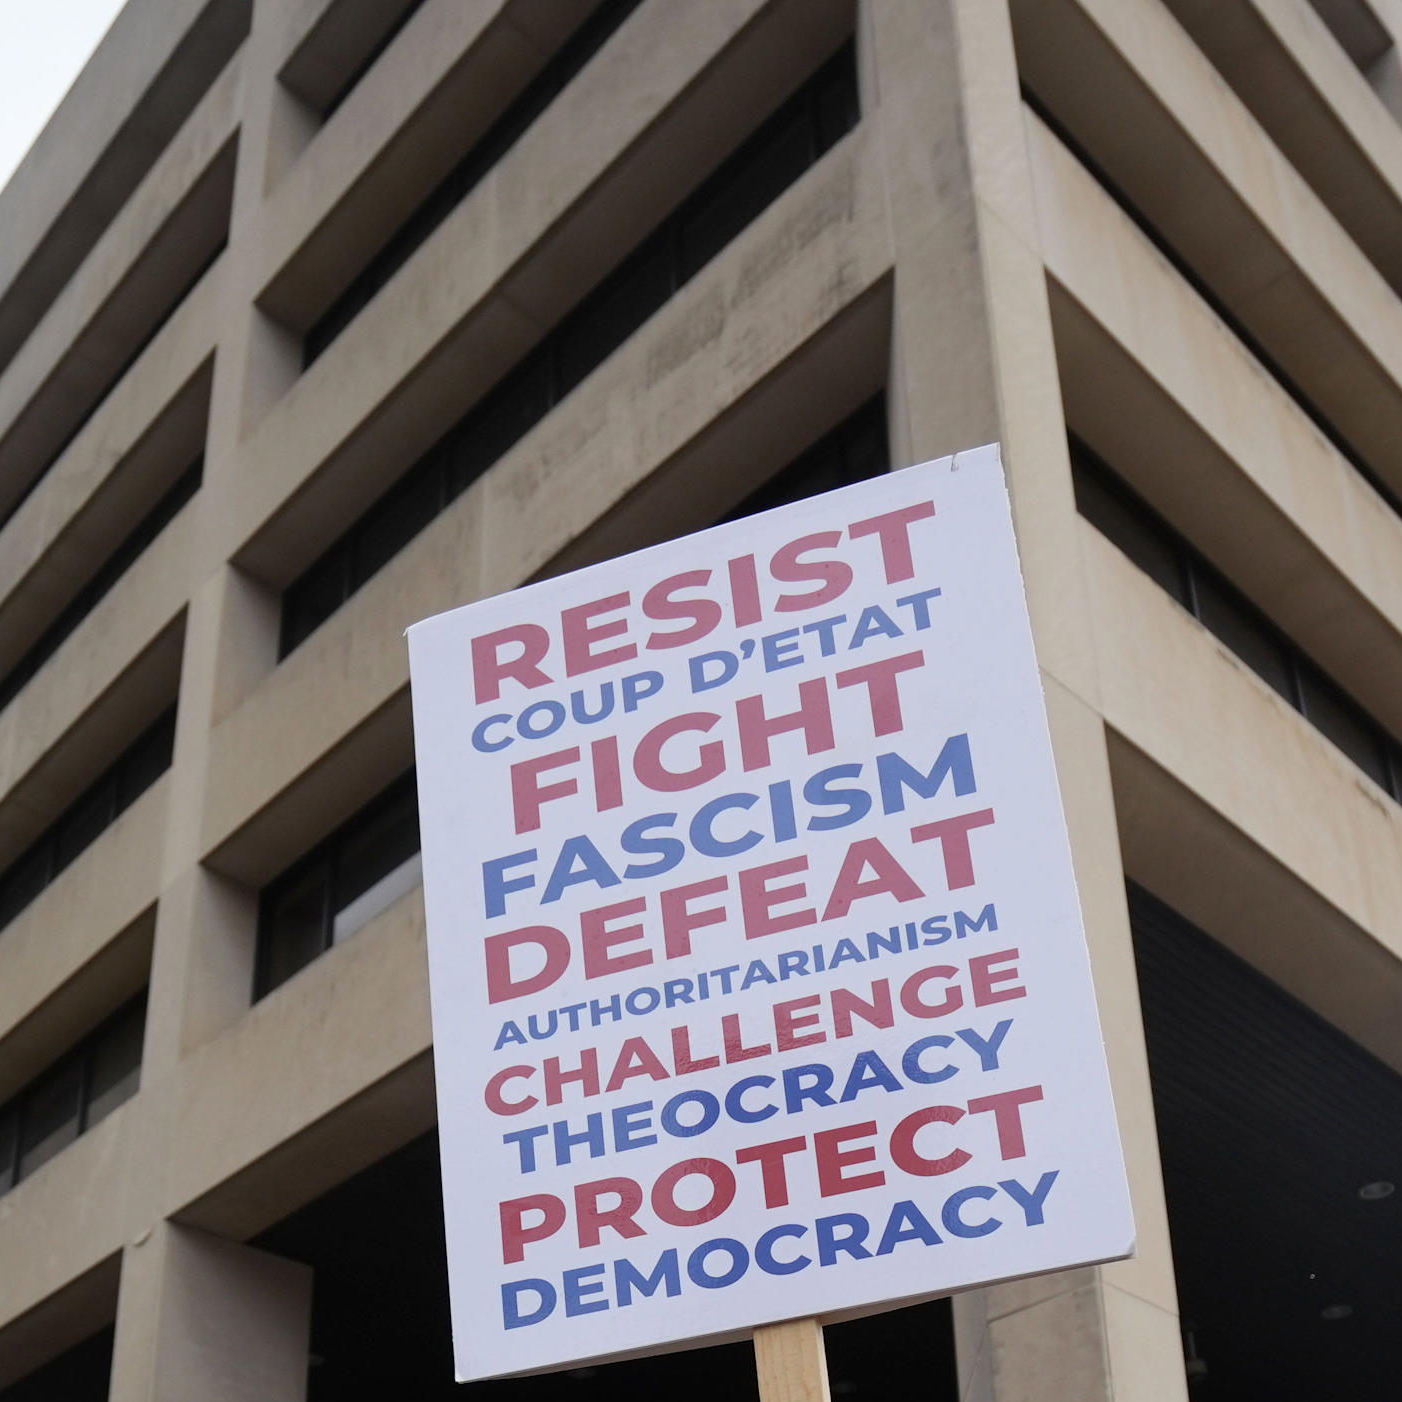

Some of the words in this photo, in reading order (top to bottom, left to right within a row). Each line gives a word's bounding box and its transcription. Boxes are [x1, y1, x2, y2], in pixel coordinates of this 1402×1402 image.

[470, 500, 936, 705] RESIST
[470, 668, 665, 755] COUP
[690, 587, 944, 695] D'ETAT
[481, 732, 978, 920] FASCISM
[509, 650, 926, 836] FIGHT
[483, 808, 998, 1005] DEFEAT
[493, 903, 999, 1051] AUTHORITARIANISM
[483, 948, 1028, 1118] CHALLENGE
[502, 1018, 1014, 1175] THEOCRACY
[499, 1085, 1044, 1265] PROTECT
[500, 1170, 1060, 1332] DEMOCRACY
